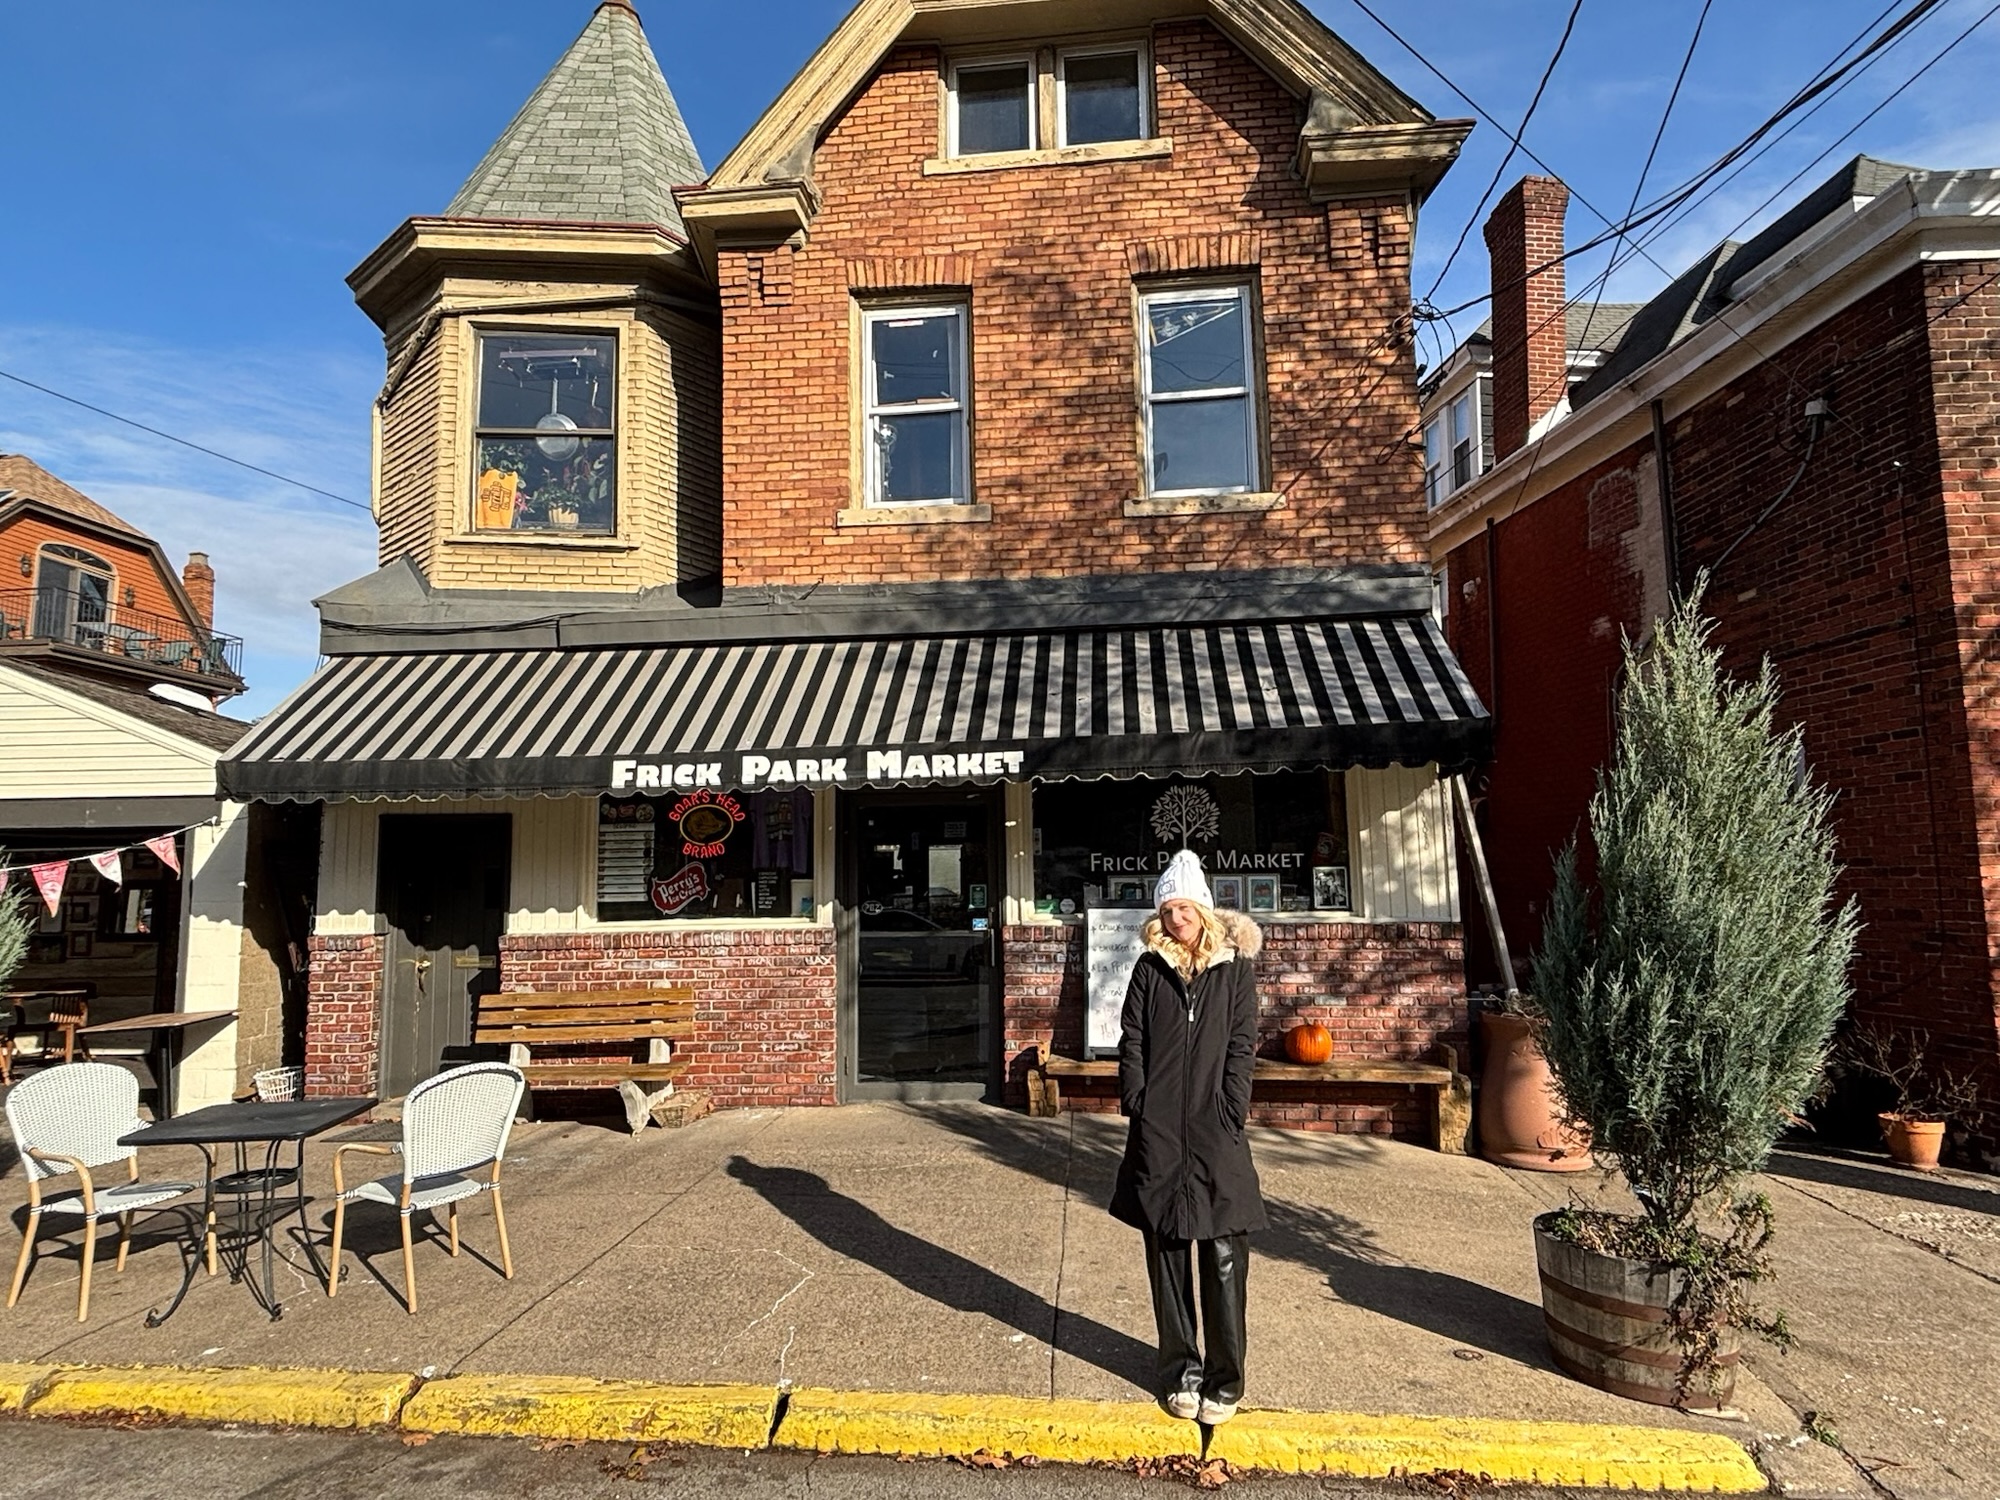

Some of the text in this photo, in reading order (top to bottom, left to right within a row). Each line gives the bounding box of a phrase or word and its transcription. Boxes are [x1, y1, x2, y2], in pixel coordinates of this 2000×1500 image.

[612, 750, 1024, 788] FRICK PARK MARKET
[669, 791, 746, 821] BOAR'S HEAD
[682, 842, 726, 858] BRAND
[1090, 849, 1305, 872] FRICK PK MARKET
[657, 872, 700, 904] Perry's
